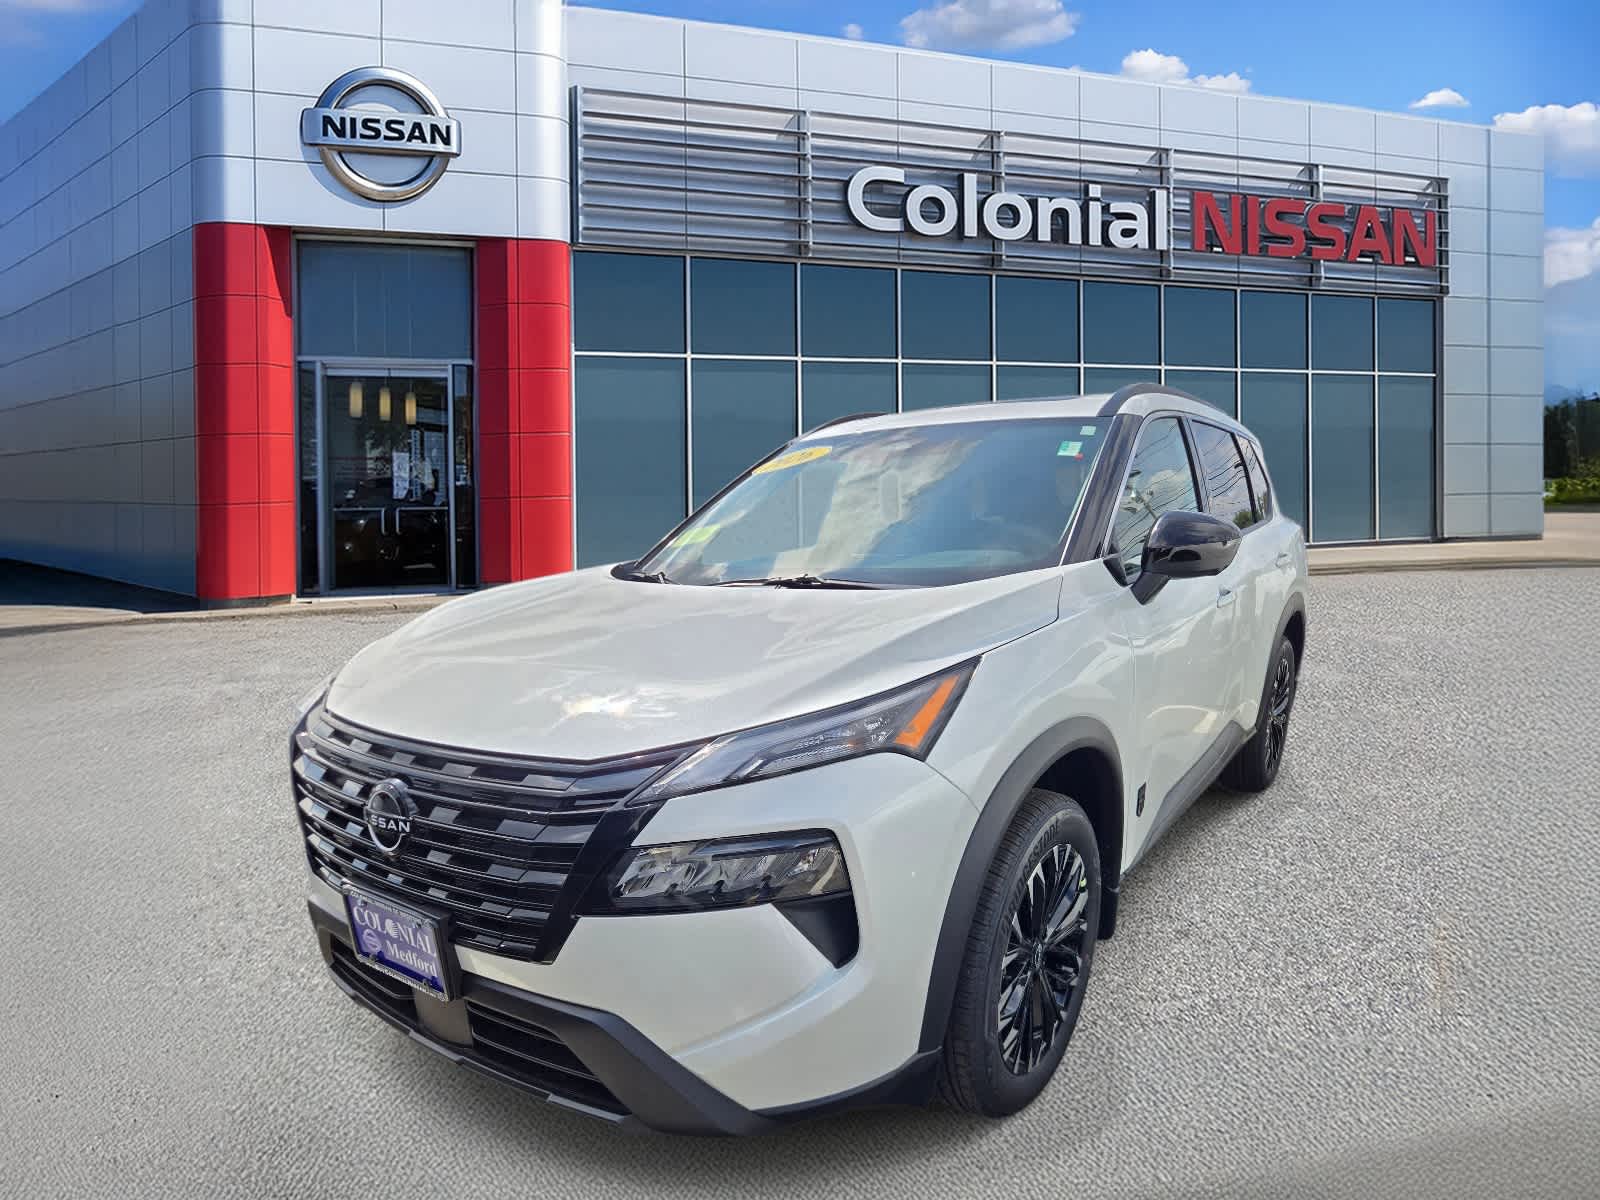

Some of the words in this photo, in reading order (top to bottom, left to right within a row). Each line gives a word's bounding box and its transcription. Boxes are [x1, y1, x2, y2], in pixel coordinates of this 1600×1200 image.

[321, 114, 452, 147] NISSAN
[847, 165, 1168, 251] Colonial
[1192, 190, 1436, 267] NISSAN
[369, 813, 411, 833] SSAN
[385, 940, 438, 977] Medford
